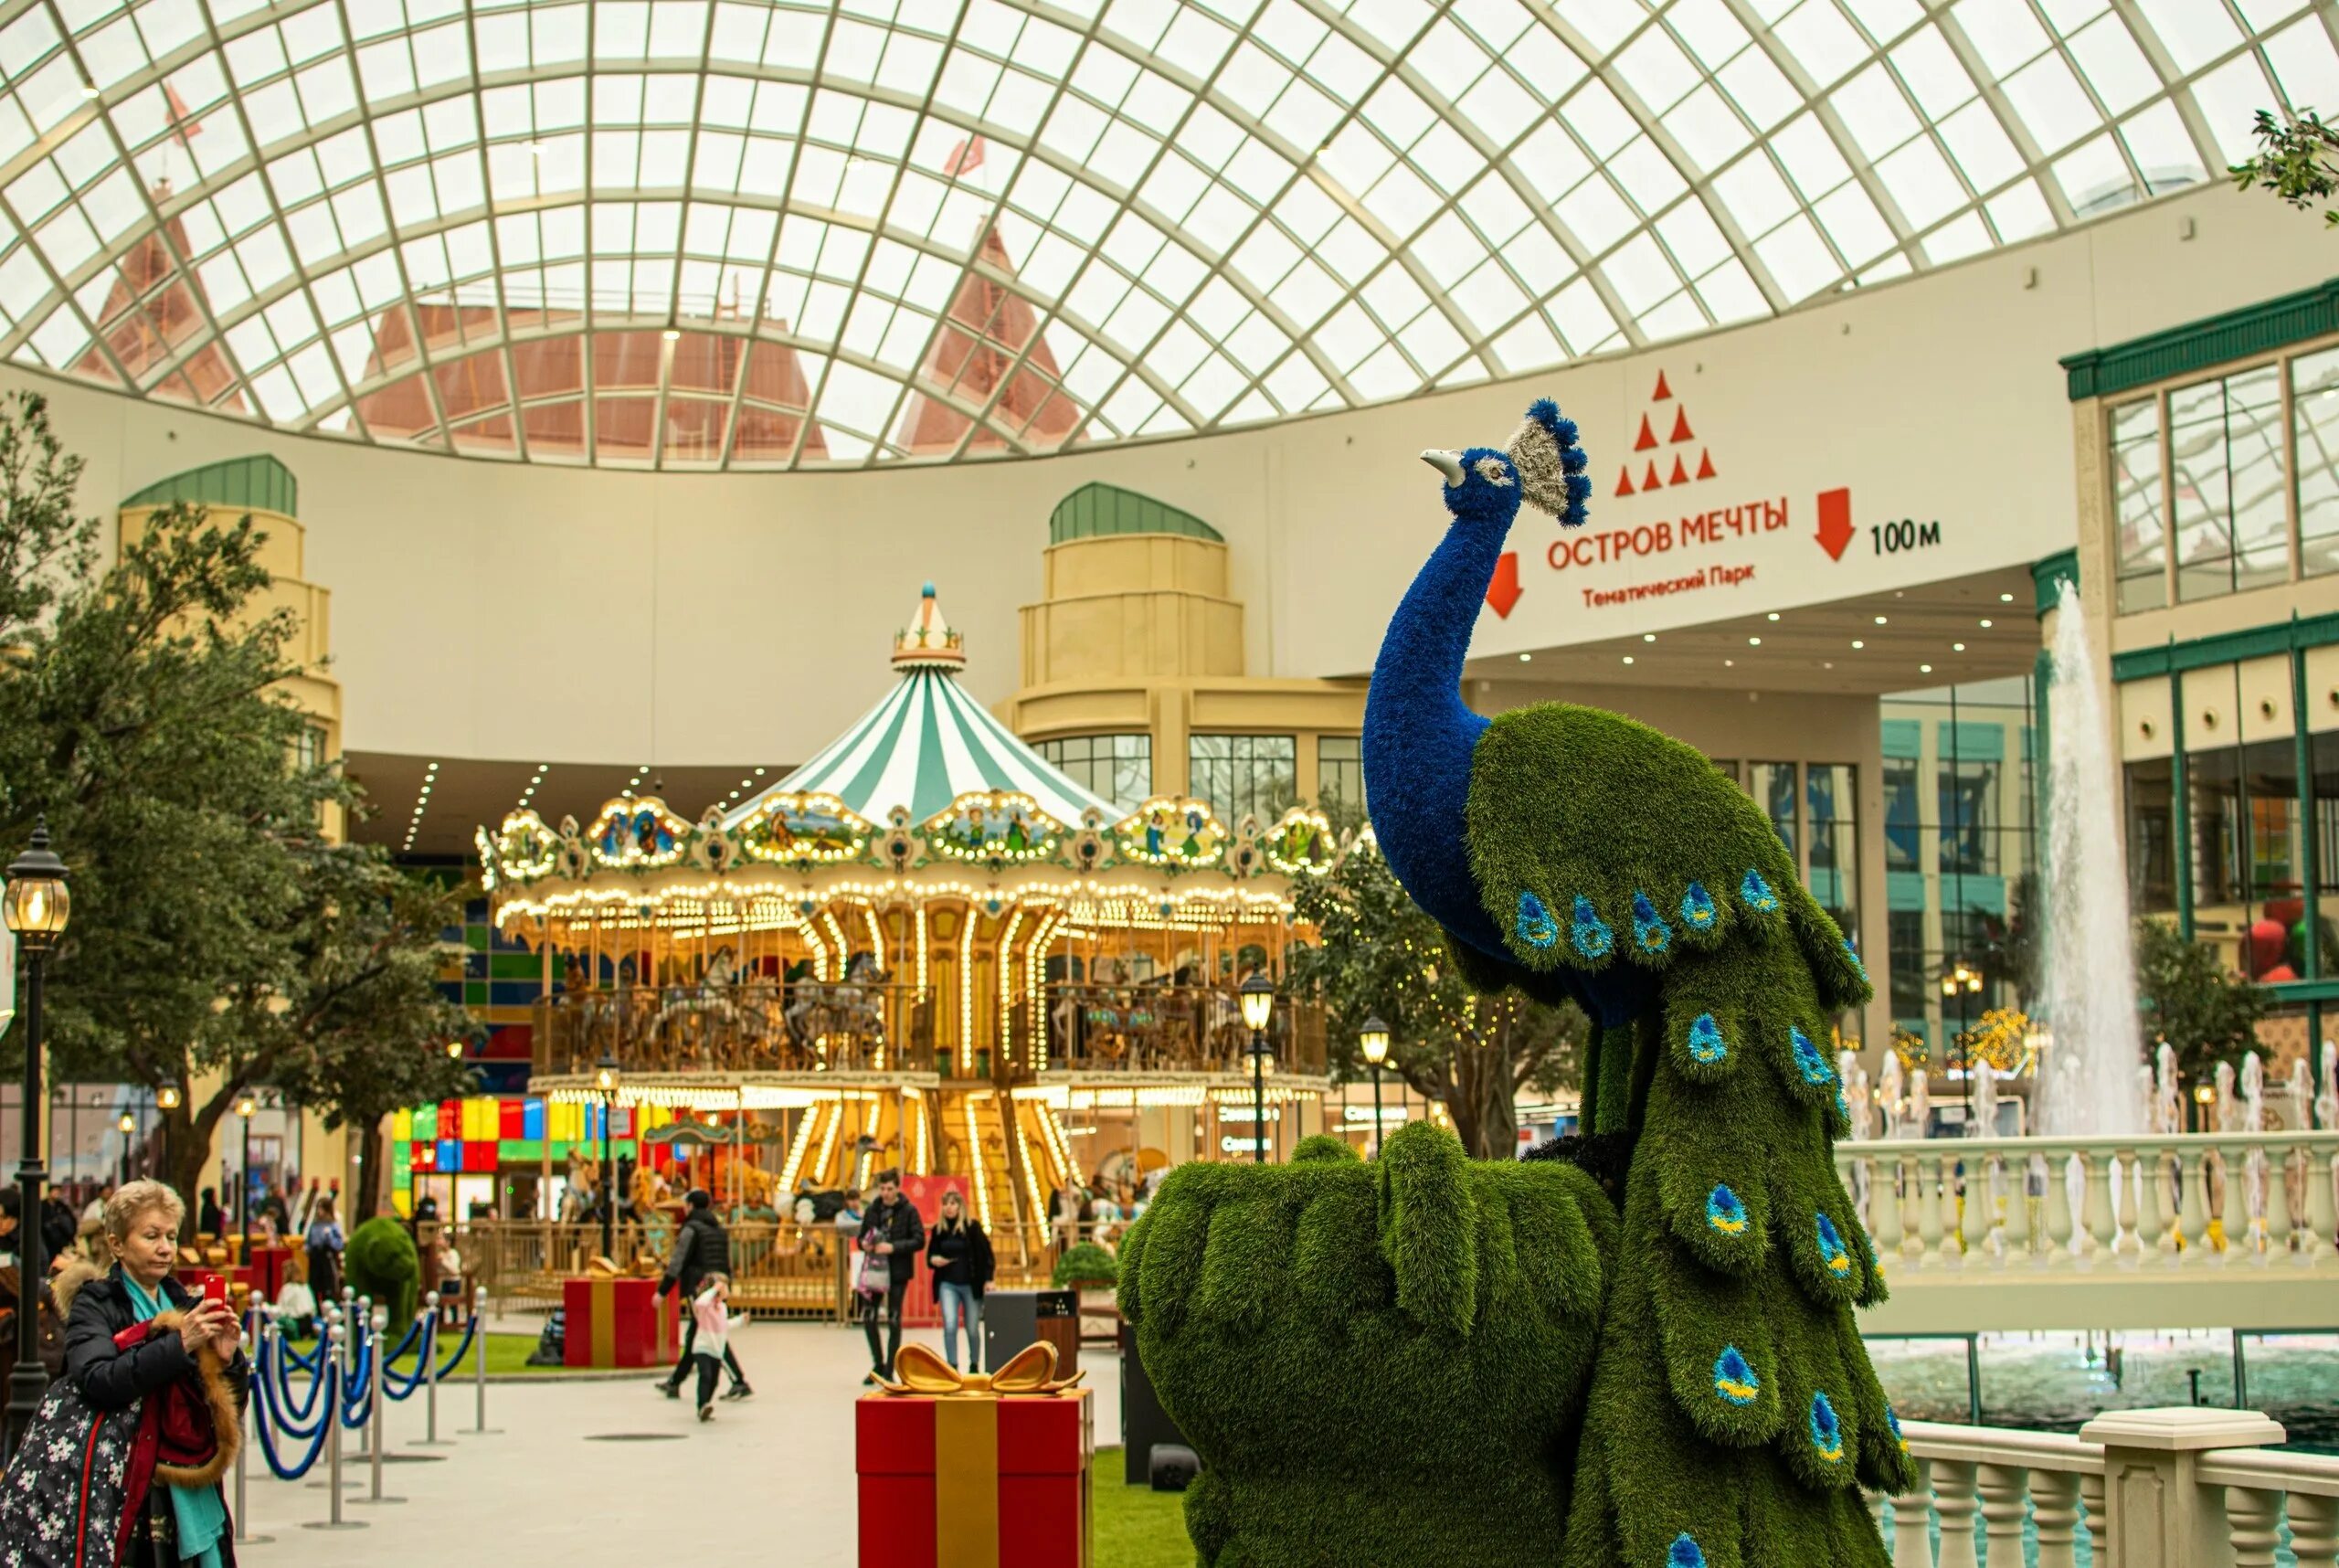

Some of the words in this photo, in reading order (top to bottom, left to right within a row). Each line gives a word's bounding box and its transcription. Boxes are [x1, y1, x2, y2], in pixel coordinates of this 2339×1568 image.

[1546, 521, 1674, 571] ОСТРОВ
[1679, 496, 1789, 547] МЕЧТЫ
[1582, 568, 1707, 609] Тематический
[1709, 564, 1755, 587] Парк
